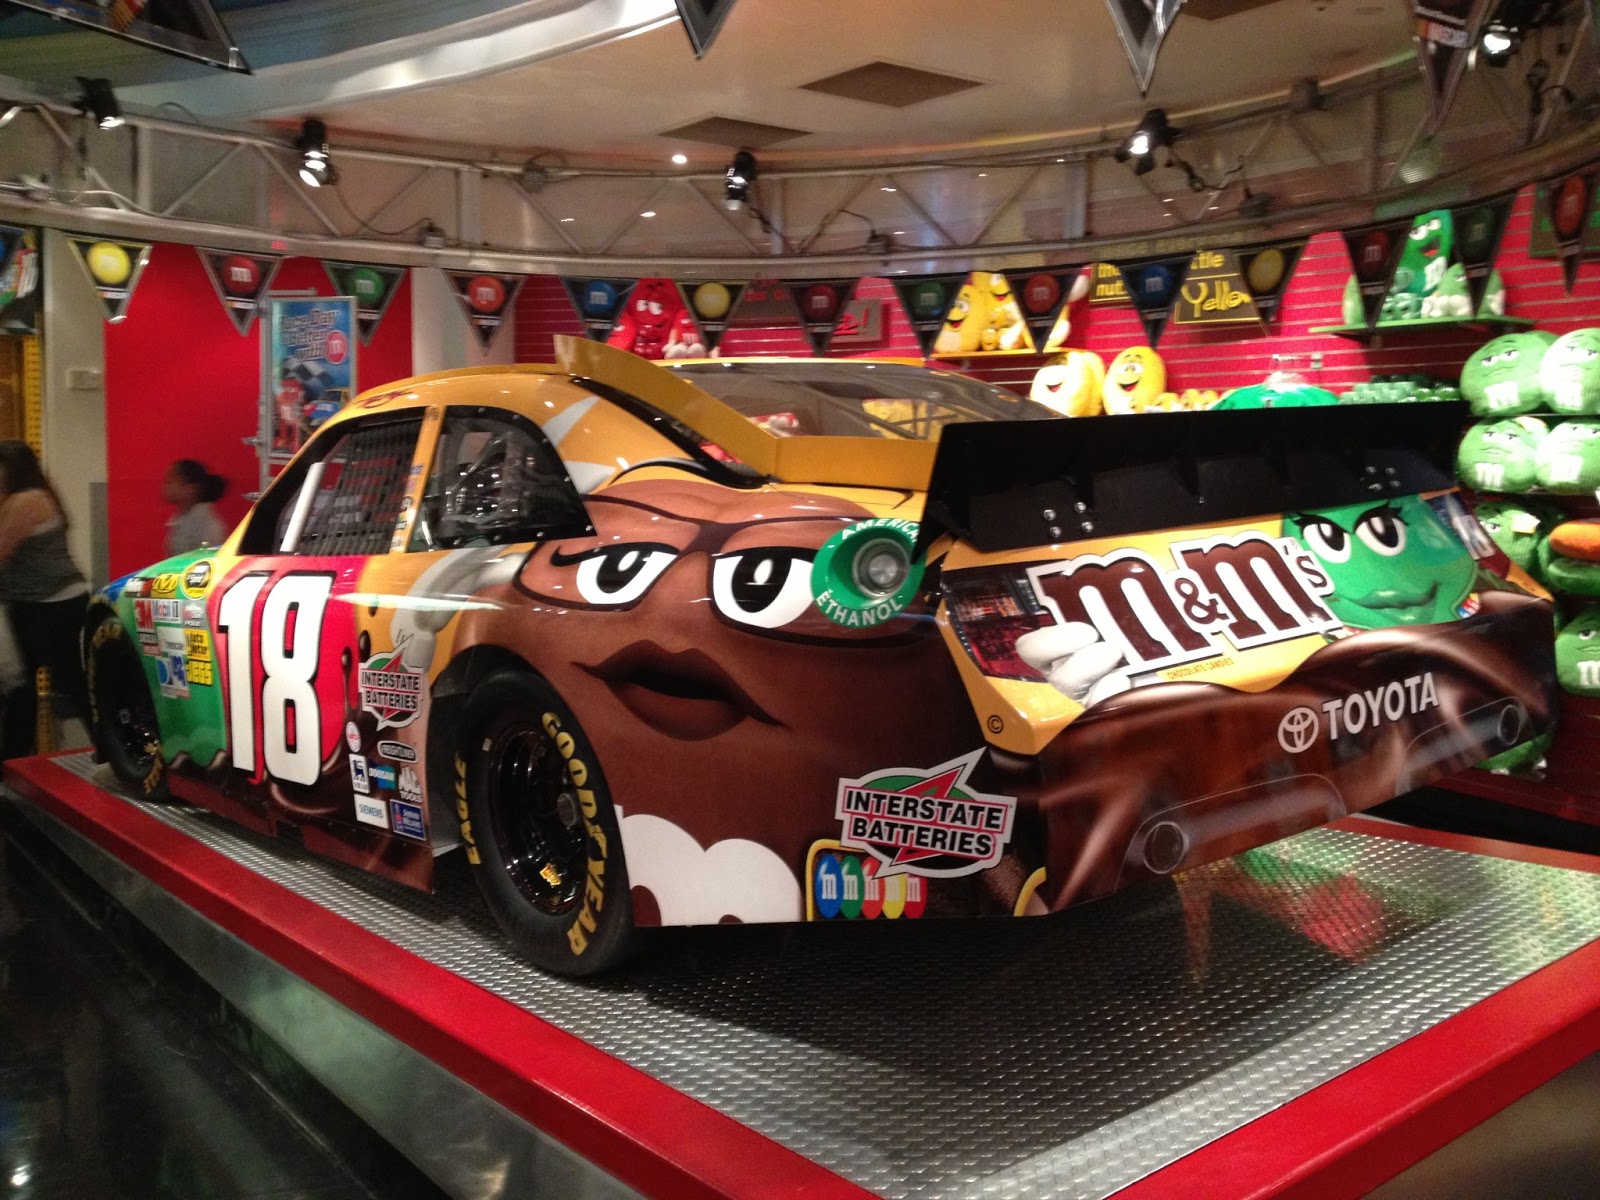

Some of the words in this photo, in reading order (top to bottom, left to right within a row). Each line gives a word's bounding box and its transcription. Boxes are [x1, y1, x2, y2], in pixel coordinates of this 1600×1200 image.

[815, 590, 904, 627] ETHANOL
[218, 570, 336, 786] 18
[361, 671, 420, 691] INTERSTATE
[365, 690, 417, 710] BATTERIES
[1322, 671, 1440, 740] TOYOTA
[846, 790, 1004, 829] INTERSTATE
[541, 711, 608, 957] GOODYEAR
[852, 817, 992, 855] BATTERIES
[821, 873, 837, 900] m
[844, 874, 859, 901] m
